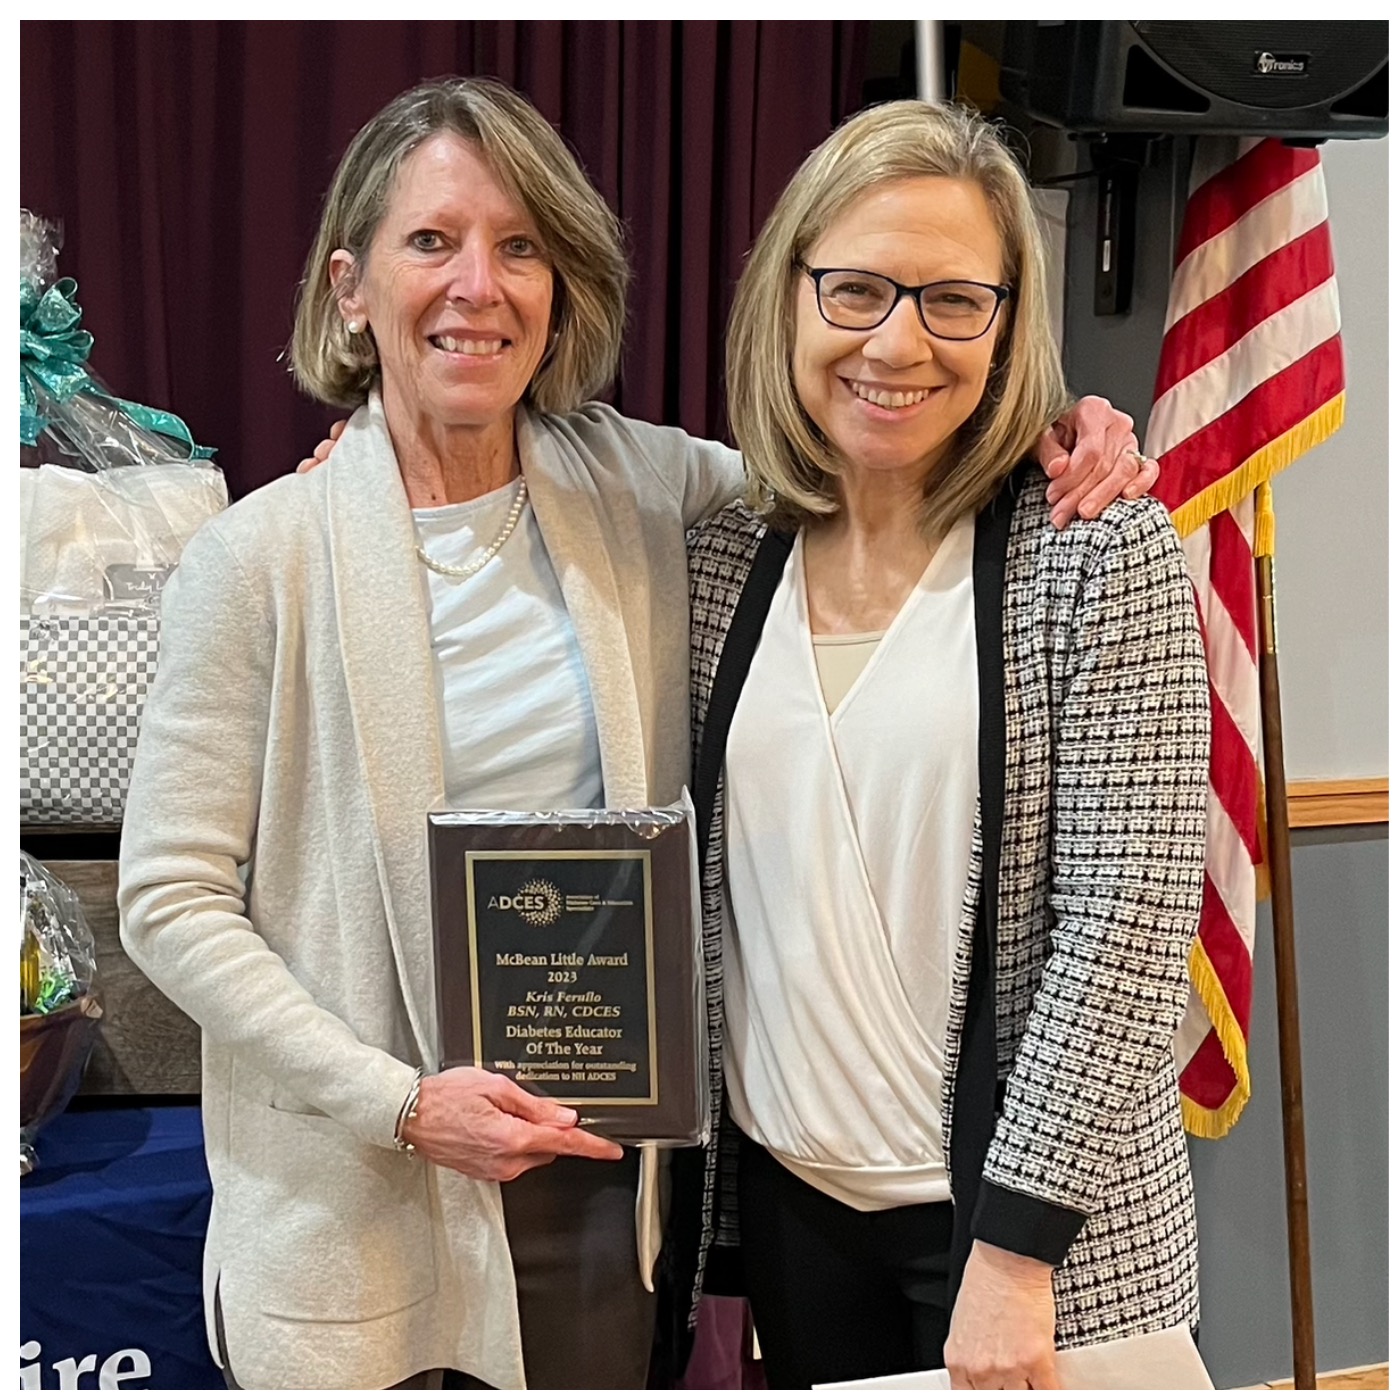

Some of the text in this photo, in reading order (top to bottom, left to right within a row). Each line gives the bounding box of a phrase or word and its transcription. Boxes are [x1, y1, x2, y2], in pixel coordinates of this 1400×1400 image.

[487, 896, 544, 910] ADCES
[496, 952, 629, 966] McBean Little Award
[547, 971, 578, 983] 2023
[525, 991, 553, 1002] Kris
[507, 1005, 621, 1018] BSN, RN, CDCES
[506, 1025, 623, 1038] Diabetes Educator
[526, 1042, 603, 1055] Of The Year
[494, 1061, 636, 1072] With appreciation for outstanding
[515, 1071, 560, 1080] dedication
[561, 1072, 570, 1080] to
[587, 1072, 617, 1080] ADCES
